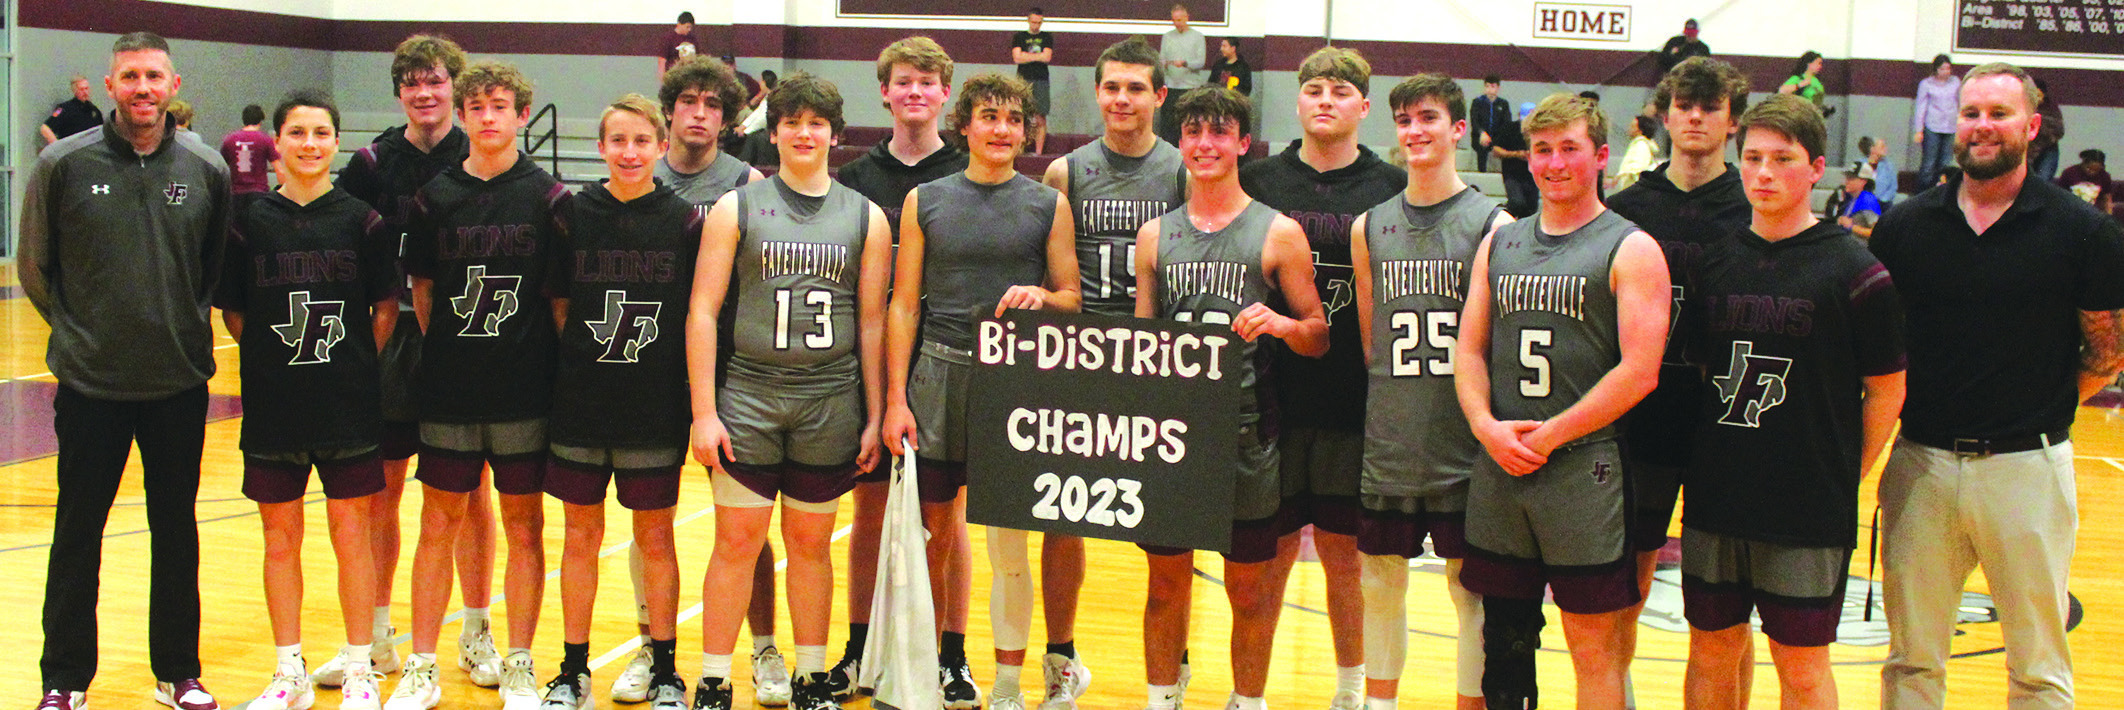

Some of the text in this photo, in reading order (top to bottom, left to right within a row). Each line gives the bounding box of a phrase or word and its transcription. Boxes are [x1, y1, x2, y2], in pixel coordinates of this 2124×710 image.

[1540, 9, 1625, 35] HOME
[1963, 3, 1993, 15] Area
[438, 223, 536, 261] LIONS
[761, 240, 847, 284] FAYETTEVILLE
[254, 249, 358, 287] LIONS
[575, 249, 677, 283] LIONS
[1166, 260, 1247, 306] FAYETTEVILLE
[1381, 259, 1463, 304] FAYETTEVILLE
[774, 289, 834, 349] 13
[1497, 274, 1587, 321] FAYETTEVILLE
[1706, 294, 1815, 336] LIONS
[1391, 311, 1458, 376] 25
[1520, 328, 1552, 398] 5
[1031, 472, 1145, 529] 2023
